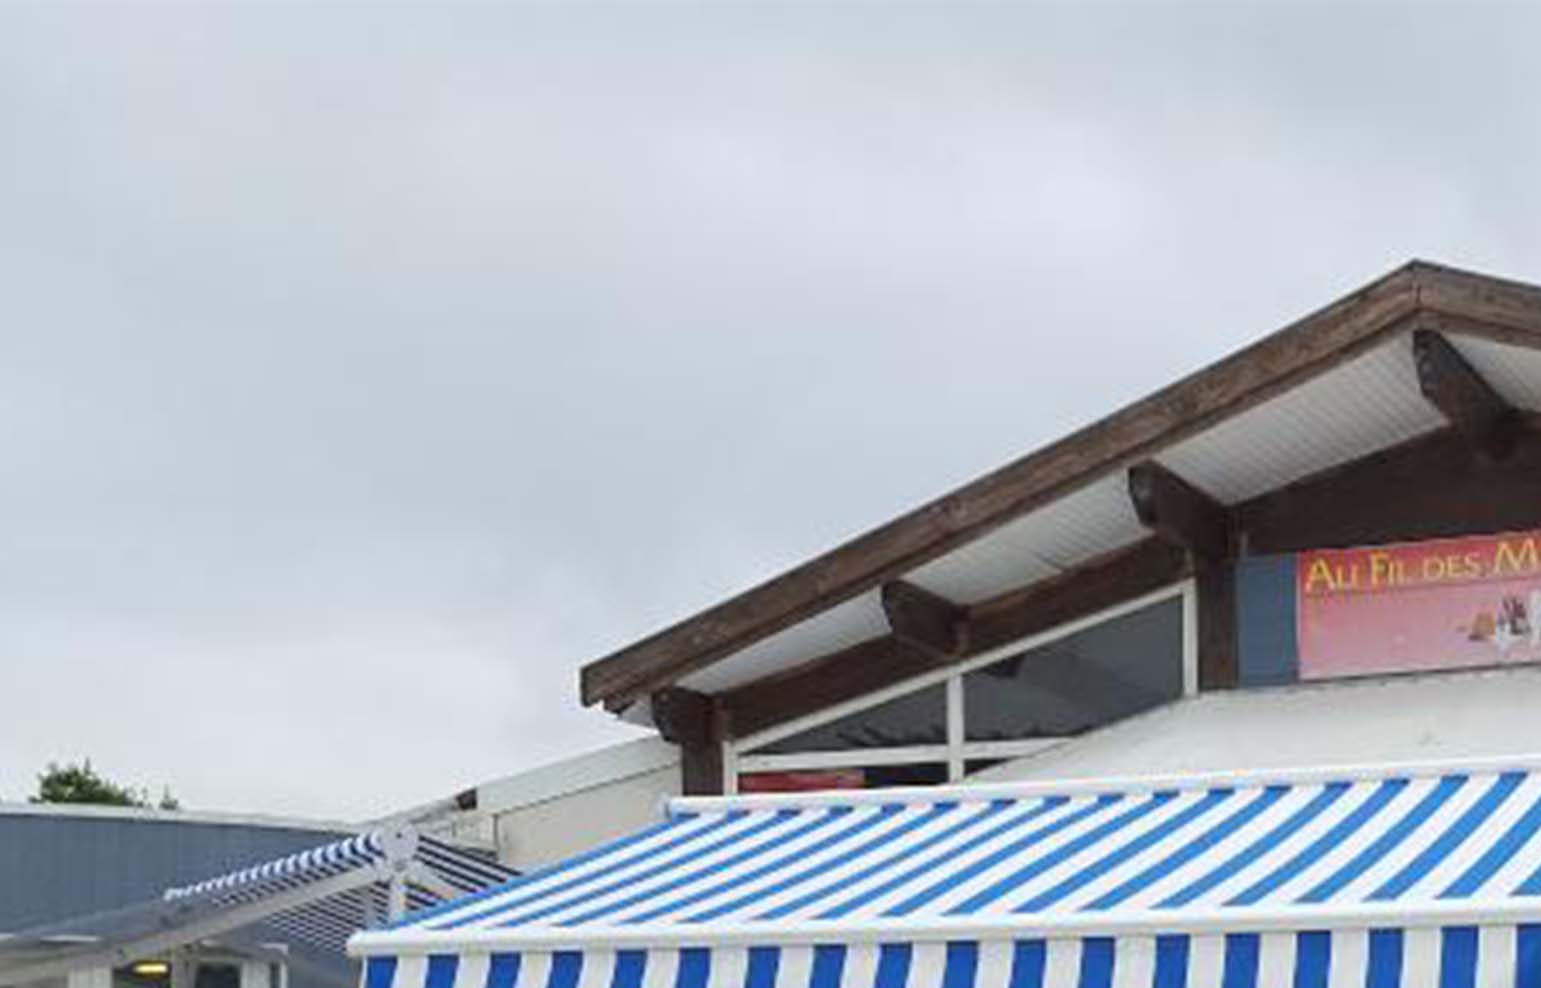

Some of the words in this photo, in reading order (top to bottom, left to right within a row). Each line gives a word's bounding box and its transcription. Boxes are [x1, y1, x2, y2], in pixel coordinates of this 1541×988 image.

[1304, 557, 1360, 593] AU
[1370, 551, 1410, 588] FIL
[1423, 551, 1484, 583] DES
